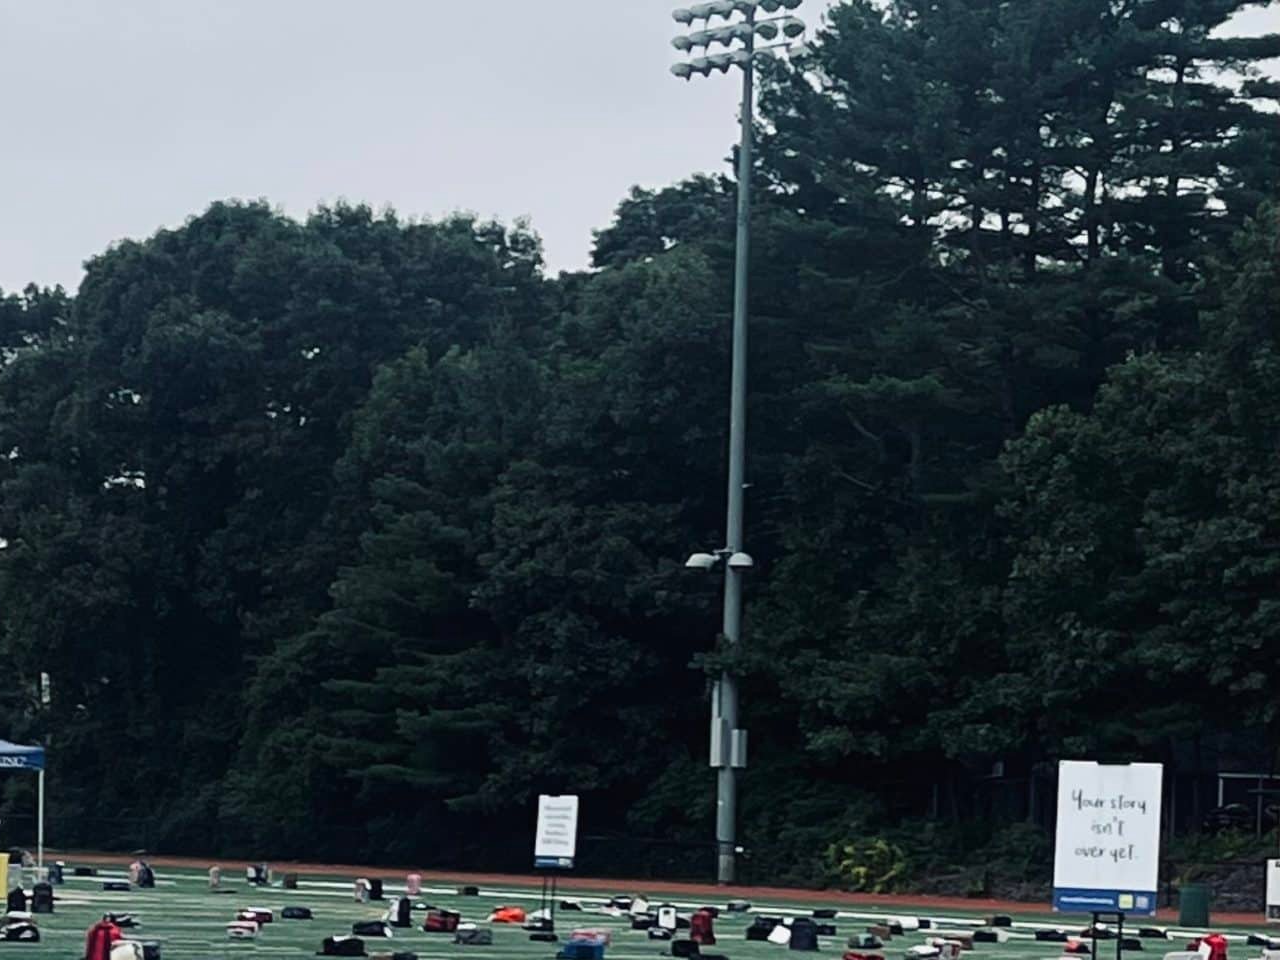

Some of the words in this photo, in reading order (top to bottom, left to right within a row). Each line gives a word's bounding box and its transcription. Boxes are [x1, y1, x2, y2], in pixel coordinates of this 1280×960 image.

[1072, 789, 1104, 811] Your
[1110, 794, 1146, 814] story
[1090, 816, 1124, 836] isn't
[1074, 846, 1104, 858] over
